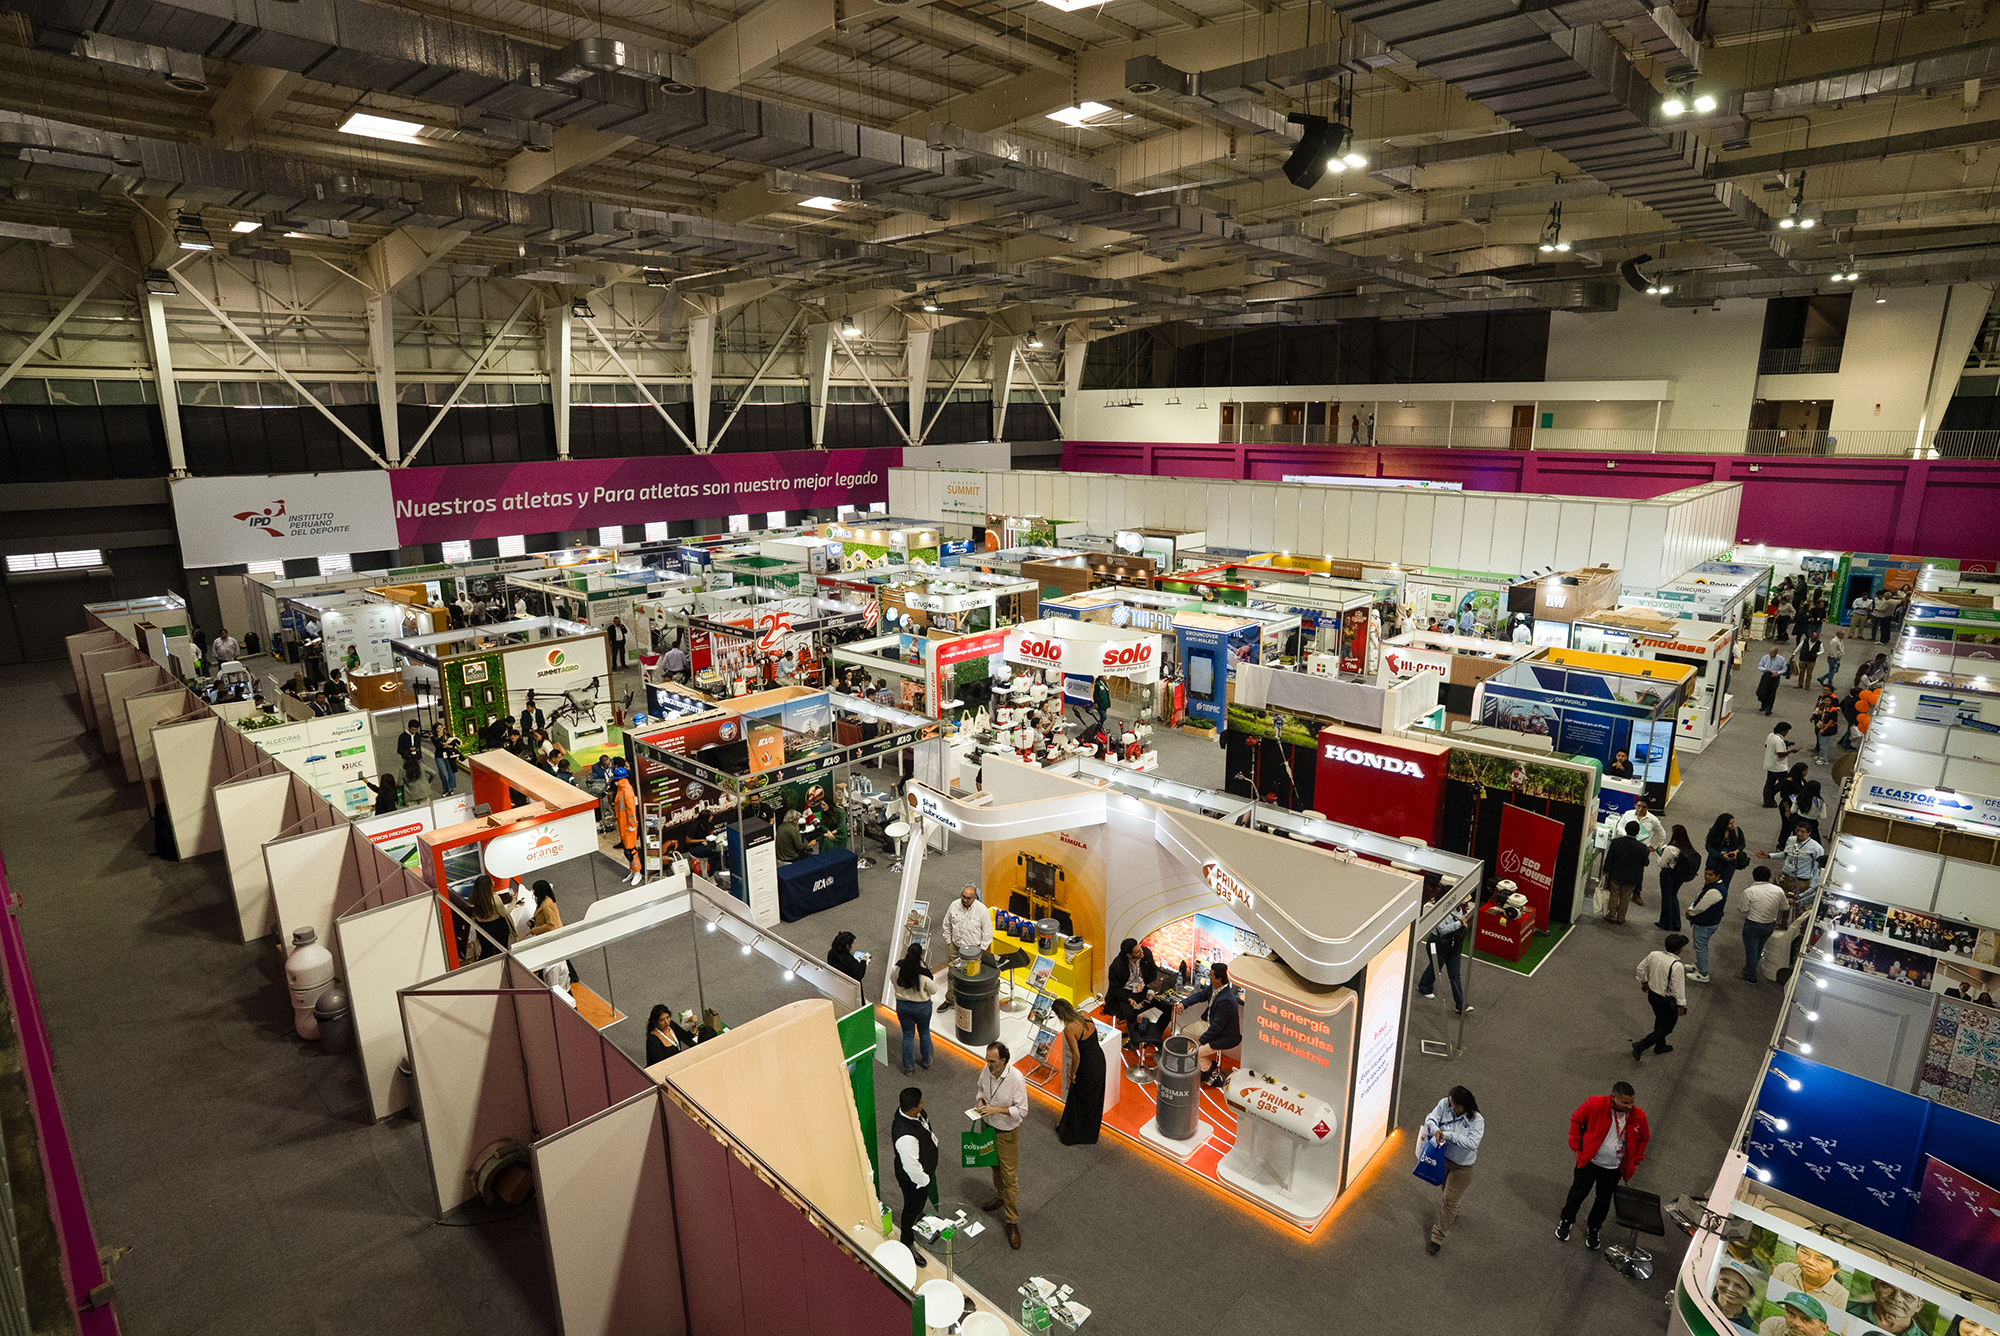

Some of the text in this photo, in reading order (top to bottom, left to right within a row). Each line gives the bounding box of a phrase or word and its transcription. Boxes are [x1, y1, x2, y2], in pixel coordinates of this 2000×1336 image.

[396, 470, 878, 519] Nuestros atletas y Para atletas son nuestro mejor legado
[947, 485, 980, 496] SUMMIT
[249, 517, 271, 527] IPD
[289, 512, 334, 522] INSTITUTO
[290, 520, 332, 529] PERUANO
[310, 525, 350, 535] DEPORTE
[1676, 586, 1711, 594] CONCURSO
[1646, 600, 1685, 610] YOYOBIN
[1130, 609, 1173, 631] TINPAC
[757, 611, 791, 650] 25
[1185, 631, 1219, 640] GROUNCOVER
[1020, 638, 1062, 660] solo
[1102, 641, 1151, 665] solo
[1642, 637, 1707, 655] modasa
[1563, 698, 1587, 706] WORLD
[265, 734, 301, 746] ALGECIRAS
[1325, 744, 1425, 779] HONDA
[1870, 785, 1937, 804] EL CASTOR
[922, 798, 937, 810] Shell
[389, 824, 422, 839] PROYECTOS
[1060, 836, 1087, 850] RIMULA
[526, 843, 564, 861] orange
[1522, 857, 1541, 871] ECO
[1520, 866, 1552, 886] POWER
[1216, 868, 1251, 908] PRIMAX
[1216, 882, 1233, 902] gas
[1481, 929, 1514, 944] HONDA
[1262, 999, 1331, 1035] La energía
[1257, 1014, 1334, 1053] que impulsa
[1258, 1030, 1330, 1068] la industria
[1161, 1086, 1189, 1098] PRIMAX
[1257, 1100, 1279, 1114] gas
[1260, 1090, 1304, 1116] PRIMAX
